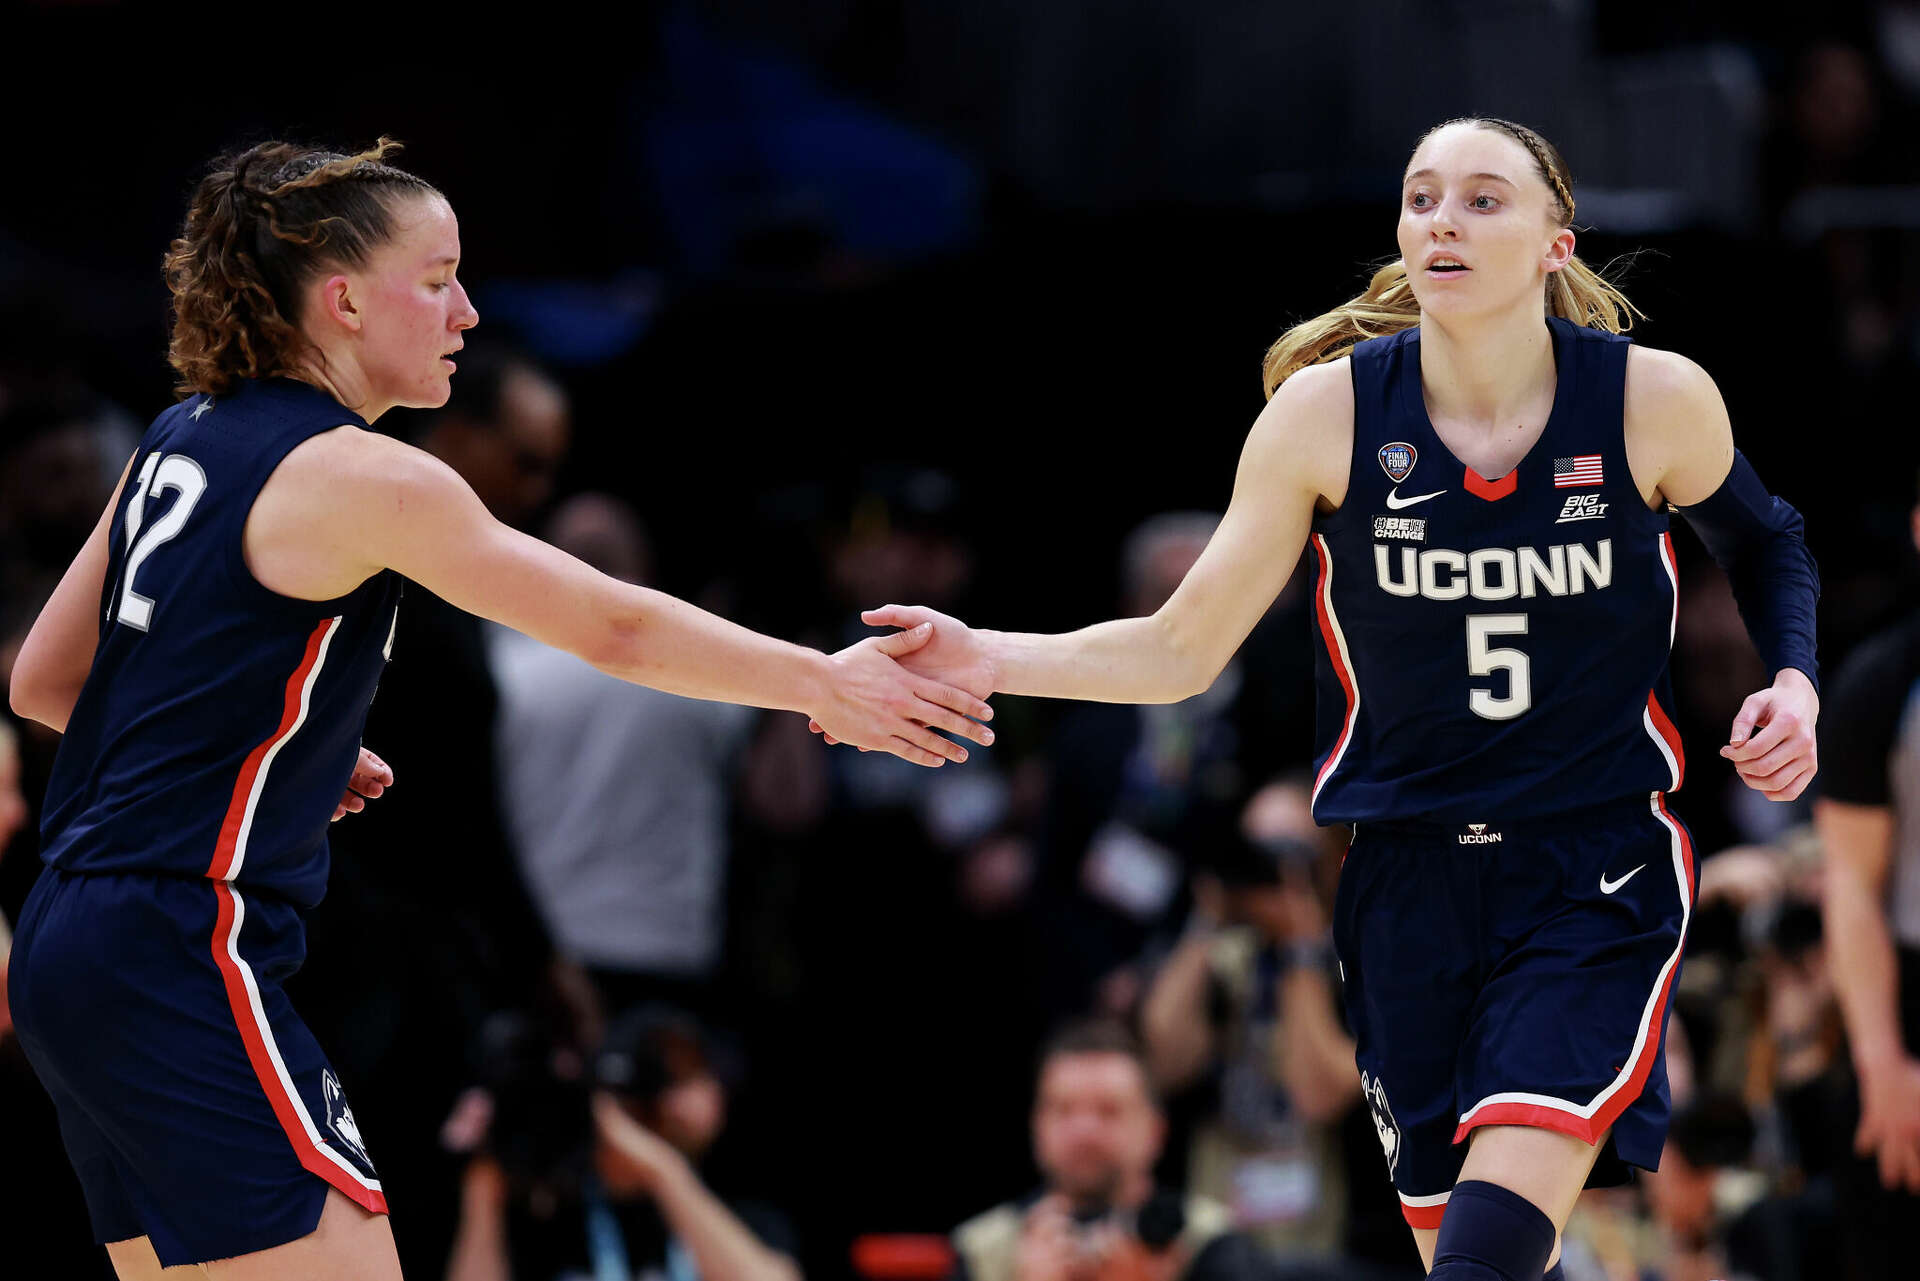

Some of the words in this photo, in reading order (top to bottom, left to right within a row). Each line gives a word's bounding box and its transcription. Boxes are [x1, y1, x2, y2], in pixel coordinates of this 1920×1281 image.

[1388, 451, 1408, 460] FINAL
[1388, 459, 1408, 468] FOUR
[1565, 493, 1600, 506] BIG
[1560, 504, 1609, 518] EAST
[1374, 530, 1424, 541] CHANGE
[1374, 538, 1612, 600] UCONN
[1466, 613, 1531, 720] 5
[1458, 832, 1502, 844] UCONN
